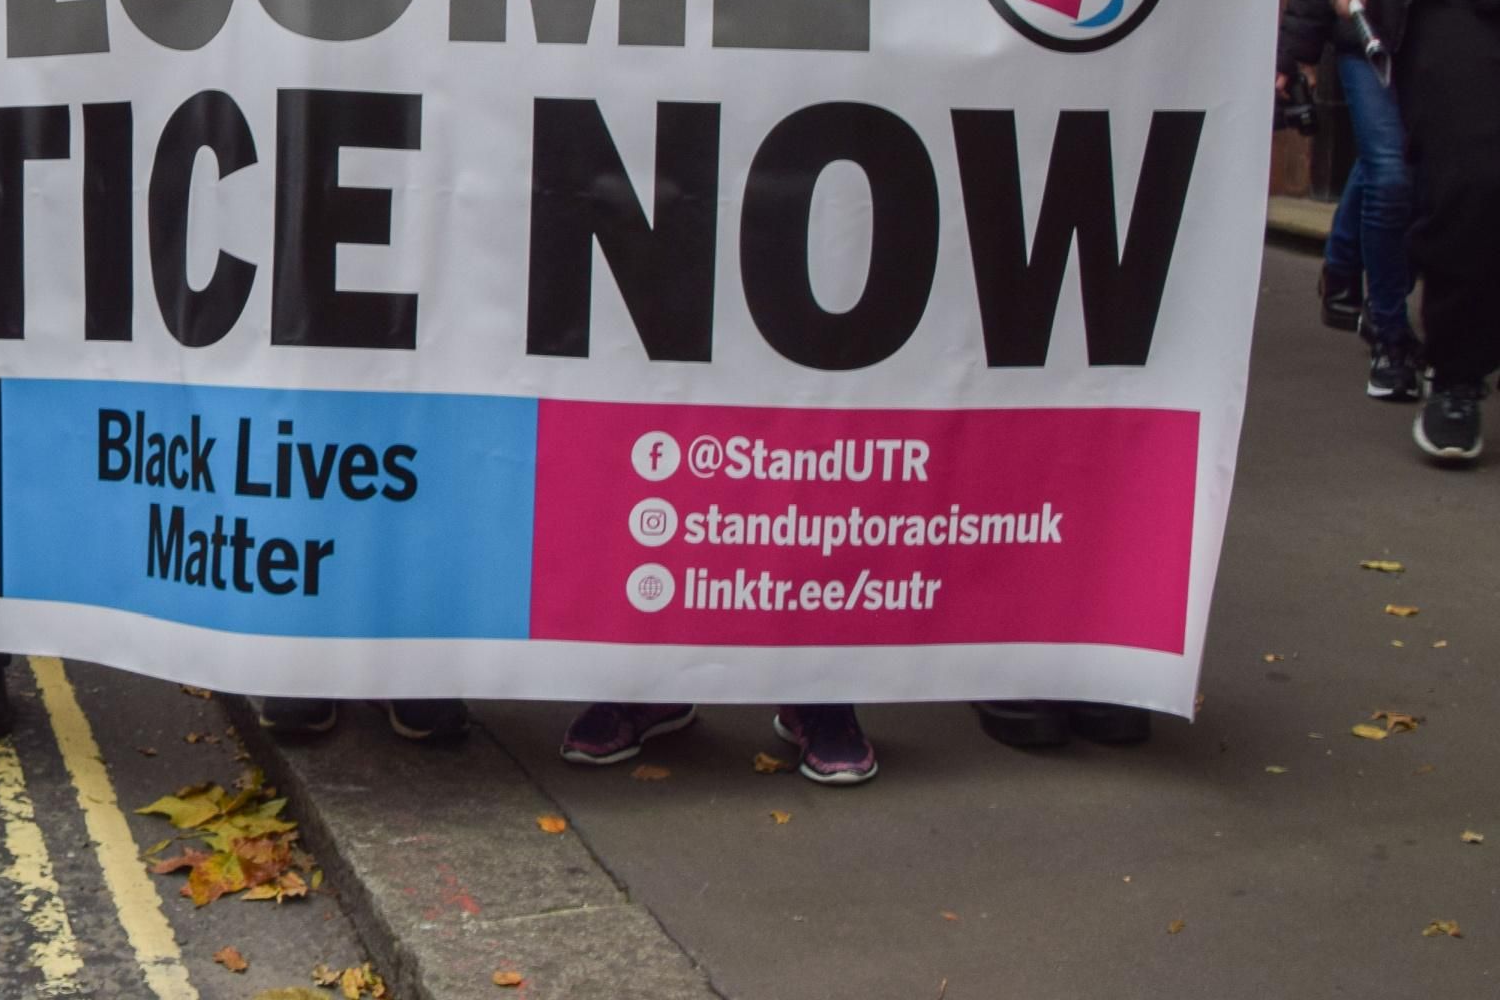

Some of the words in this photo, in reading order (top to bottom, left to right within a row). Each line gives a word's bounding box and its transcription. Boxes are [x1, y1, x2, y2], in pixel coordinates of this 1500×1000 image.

[526, 96, 1206, 371] NOW
[98, 408, 216, 494] Black
[234, 416, 420, 503] Lives
[687, 434, 931, 484] @StandUTR
[146, 503, 336, 598] Matter
[683, 506, 1063, 558] standuptoracismuk
[683, 568, 943, 614] linktr.ee/sutr
